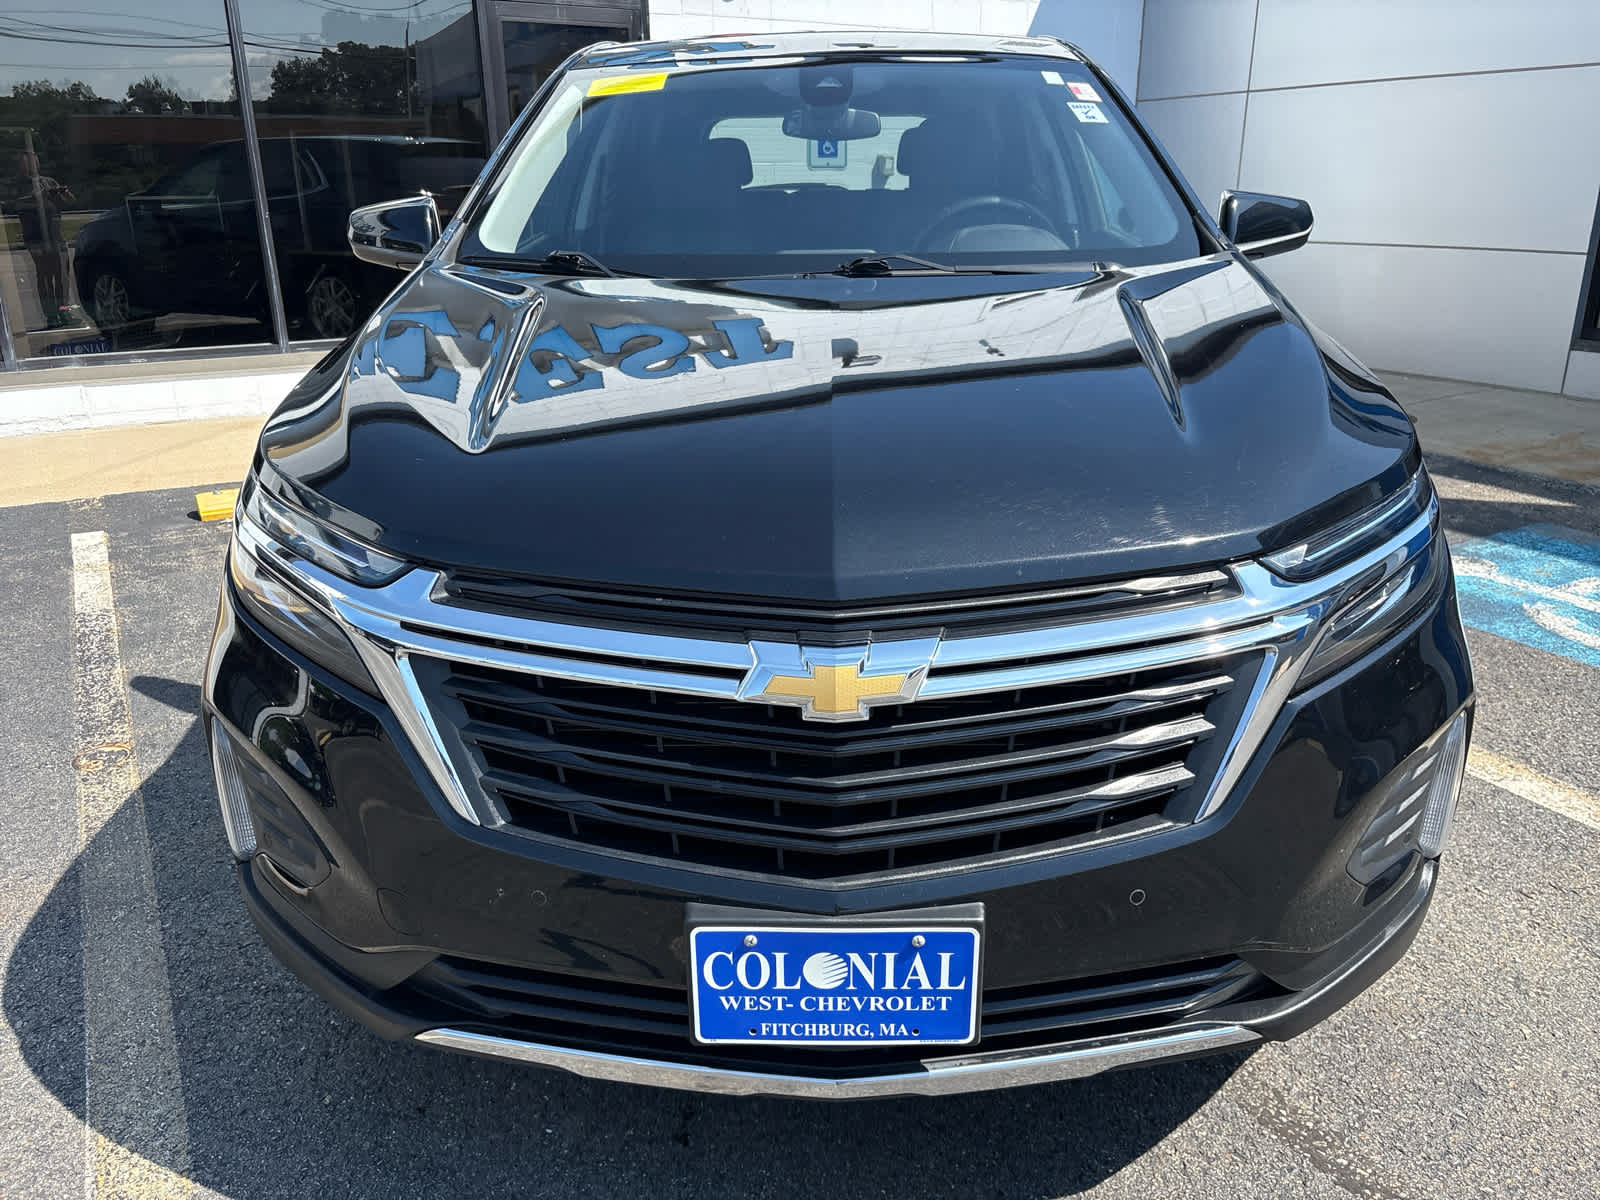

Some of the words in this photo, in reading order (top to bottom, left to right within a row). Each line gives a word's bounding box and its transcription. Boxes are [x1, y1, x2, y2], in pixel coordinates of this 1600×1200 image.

[703, 951, 966, 990] COLONIAL
[721, 996, 794, 1011] WEST-
[800, 996, 952, 1011] CHEVROLET
[761, 1022, 874, 1038] FITCHBURG,
[879, 1022, 908, 1036] MA
